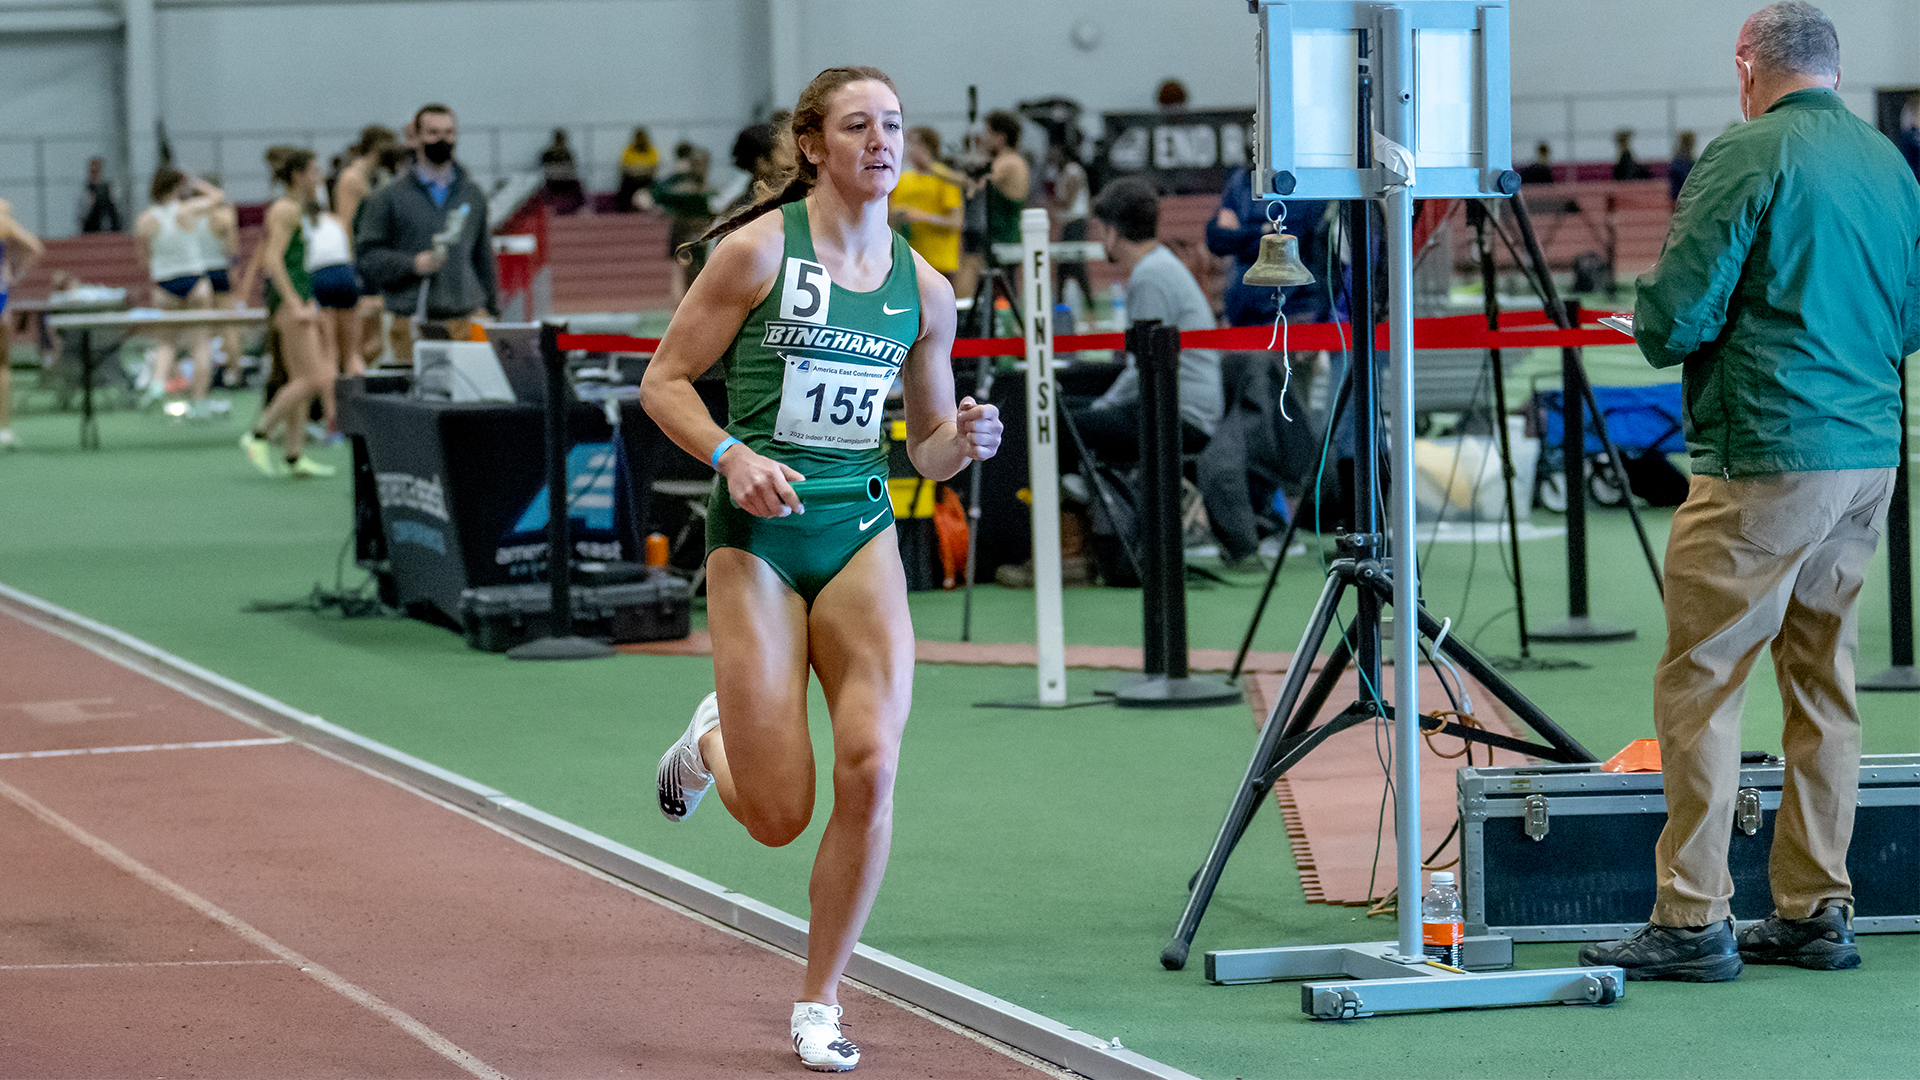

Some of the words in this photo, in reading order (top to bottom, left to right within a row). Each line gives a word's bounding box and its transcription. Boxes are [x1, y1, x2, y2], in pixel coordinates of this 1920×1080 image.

[792, 262, 823, 317] 5
[768, 325, 908, 366] BINGHAMTO
[1034, 251, 1051, 444] FINISH
[813, 365, 838, 375] America
[839, 369, 852, 377] East
[853, 370, 883, 379] Conference
[806, 383, 879, 427] 155
[789, 430, 804, 440] 2022
[805, 433, 823, 442] Indoor
[1451, 924, 1459, 968] taminwater
